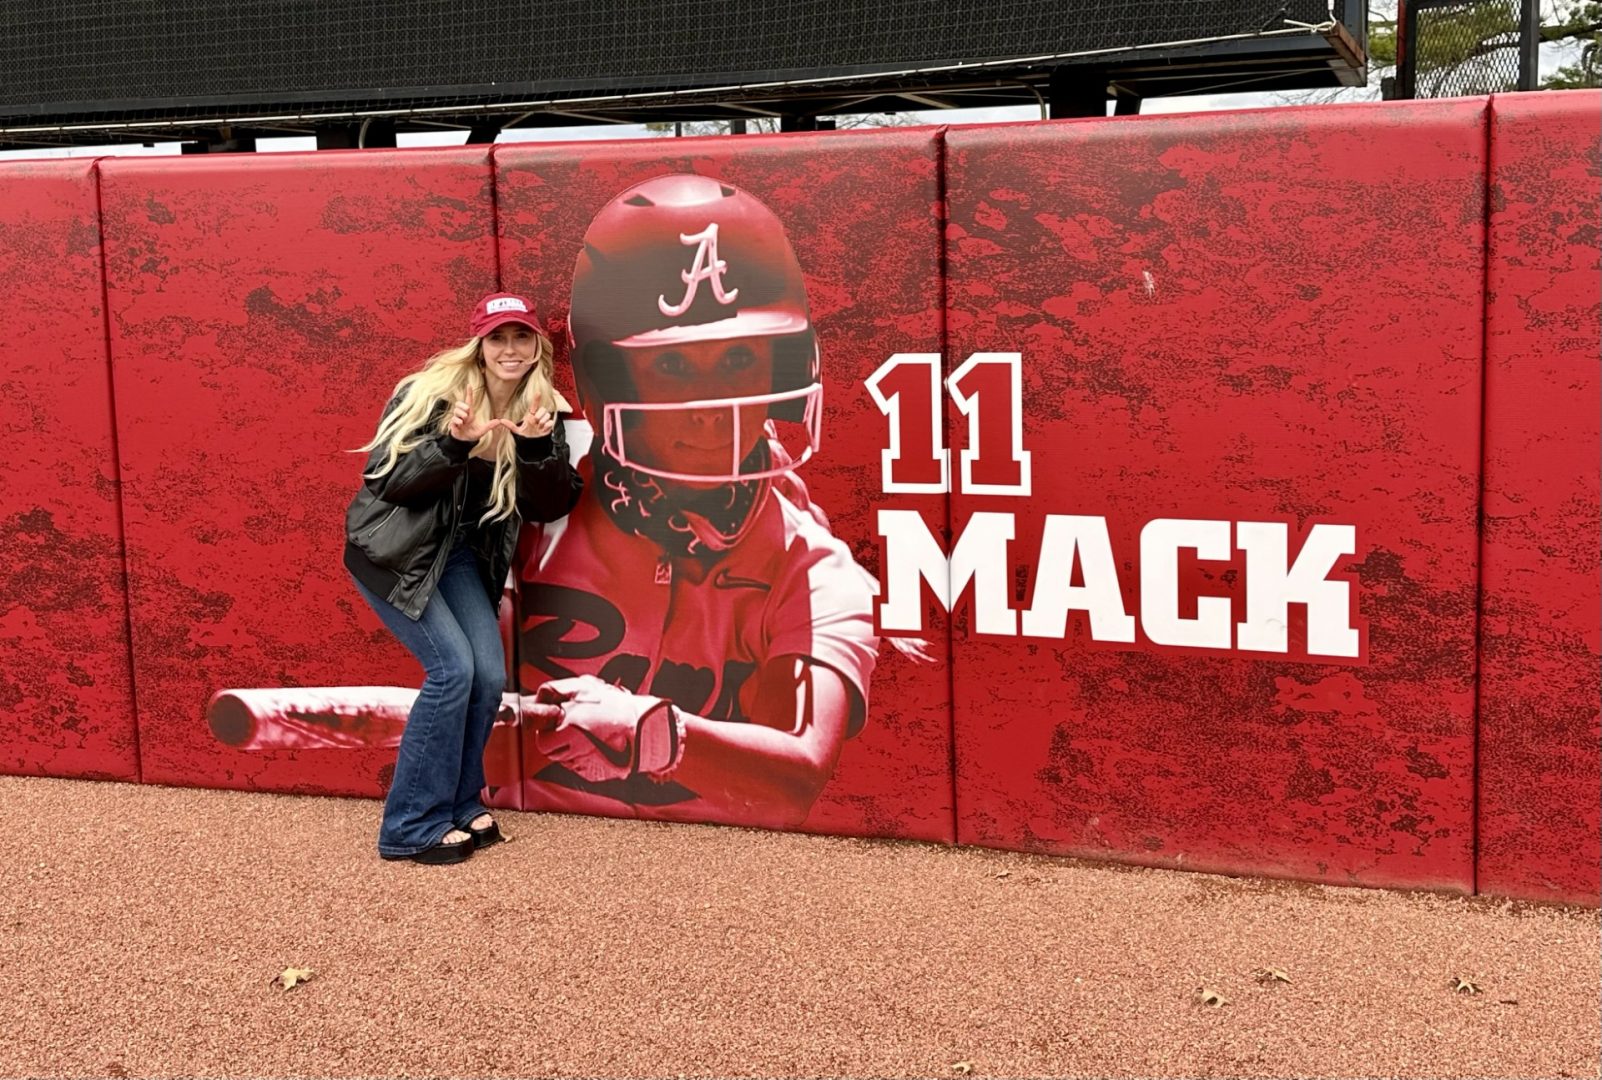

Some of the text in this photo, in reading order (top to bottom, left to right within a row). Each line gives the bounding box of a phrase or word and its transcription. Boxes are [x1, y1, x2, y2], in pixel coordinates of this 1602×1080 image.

[658, 222, 739, 316] A
[864, 352, 1032, 496] 11
[877, 509, 1360, 658] MACK
